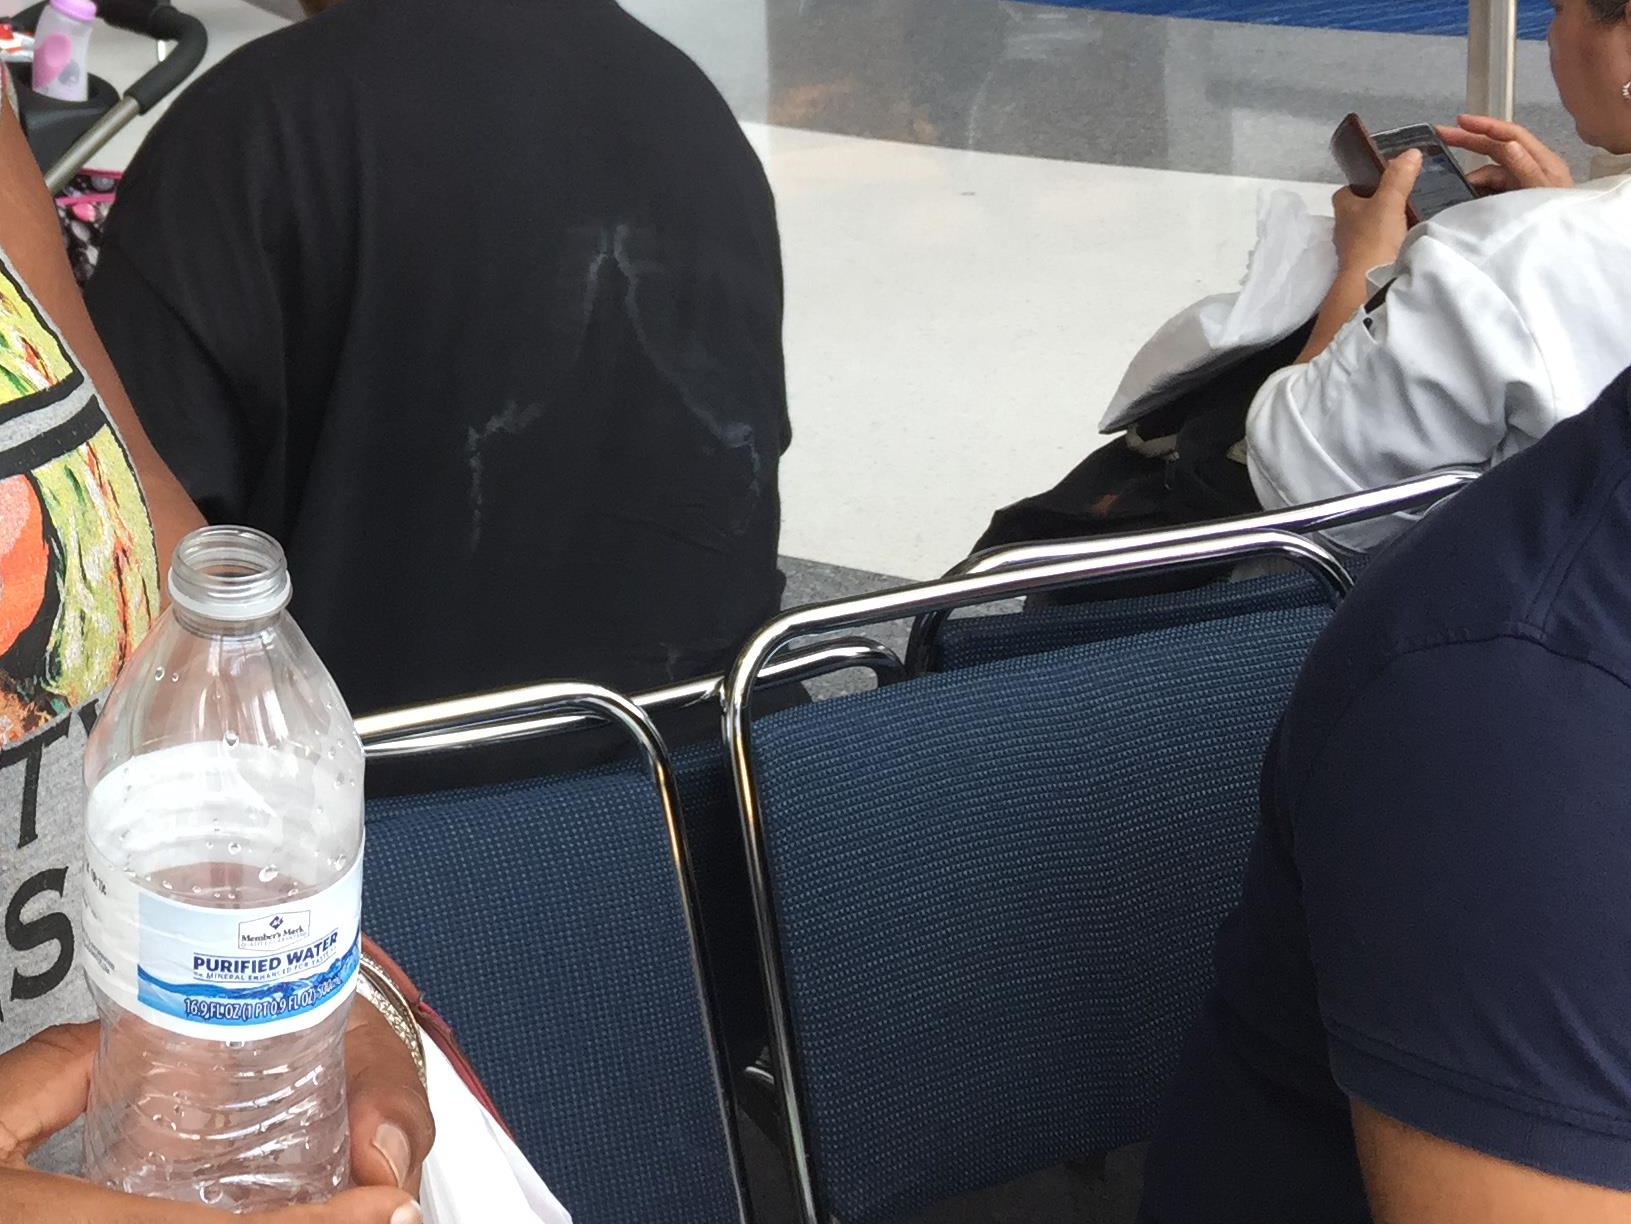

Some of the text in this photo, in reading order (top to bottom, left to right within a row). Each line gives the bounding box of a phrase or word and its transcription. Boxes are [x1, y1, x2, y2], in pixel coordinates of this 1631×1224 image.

[193, 955, 282, 975] PURIFIED
[286, 931, 338, 965] WATER
[184, 997, 209, 1017] 16.9
[225, 1003, 241, 1019] OZ
[255, 1000, 269, 1017] PT
